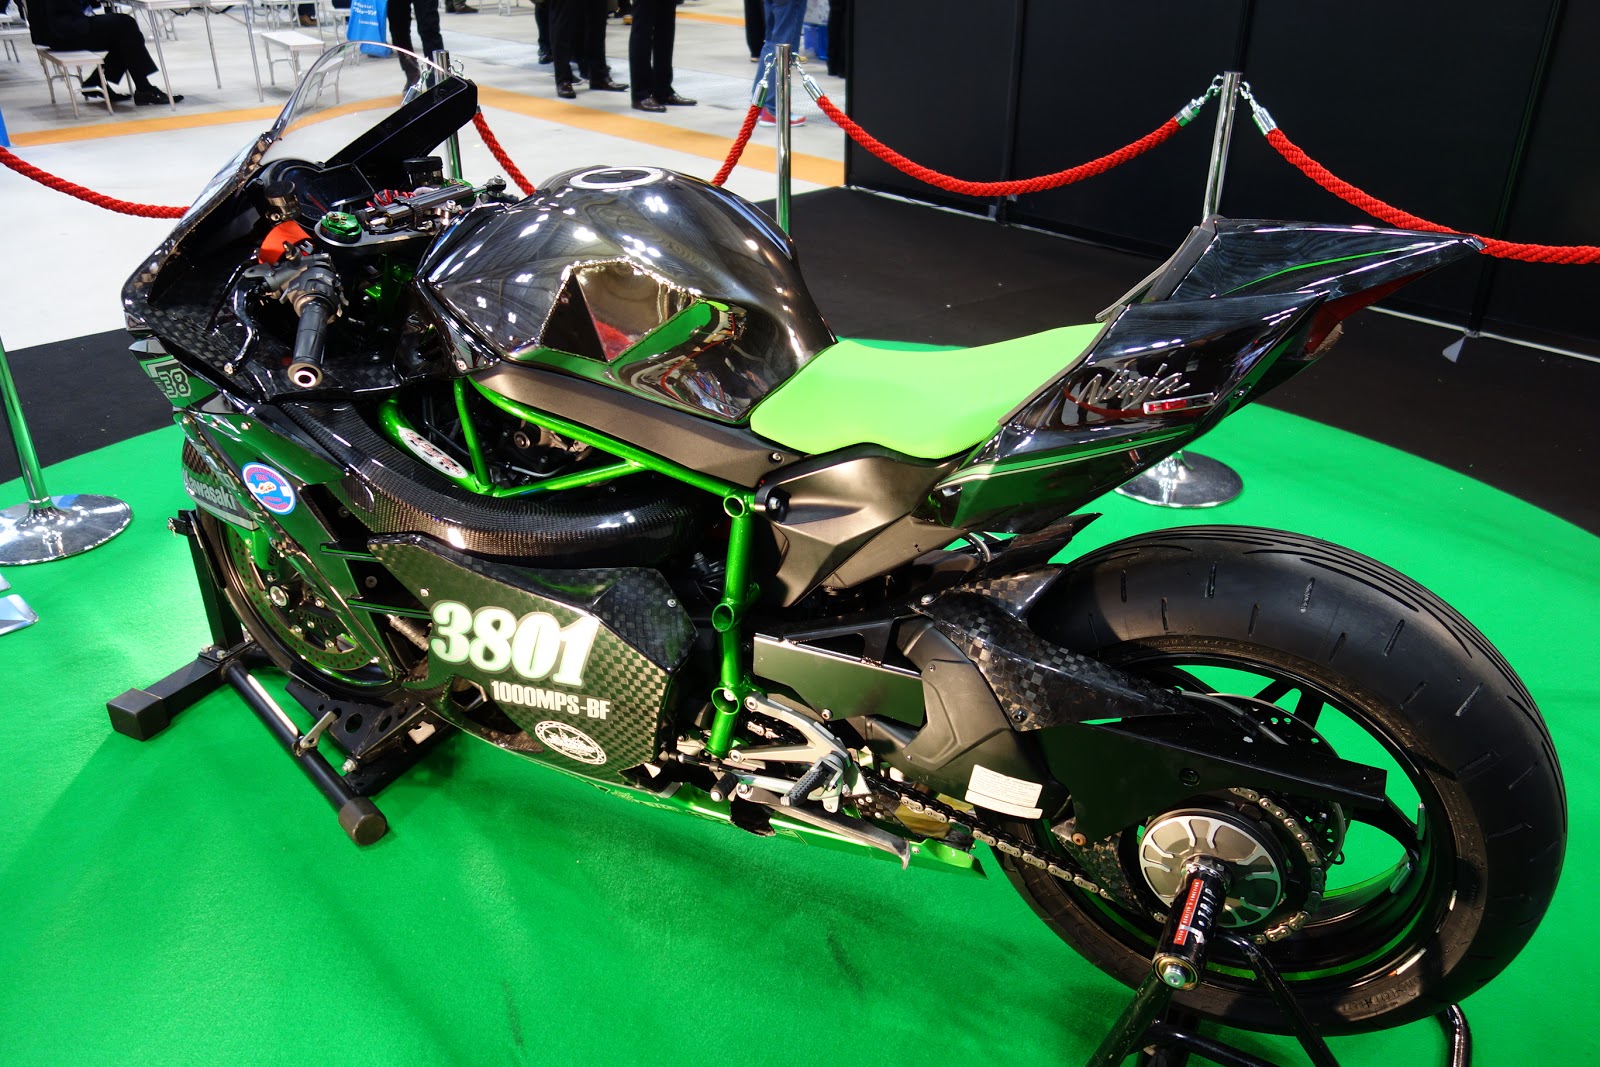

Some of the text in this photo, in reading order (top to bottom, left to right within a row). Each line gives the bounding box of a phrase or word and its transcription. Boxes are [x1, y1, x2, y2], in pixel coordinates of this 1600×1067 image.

[158, 368, 191, 398] 38
[1076, 363, 1190, 411] Ninja
[430, 602, 600, 687] 3801
[491, 680, 611, 720] 1000MPS-BF
